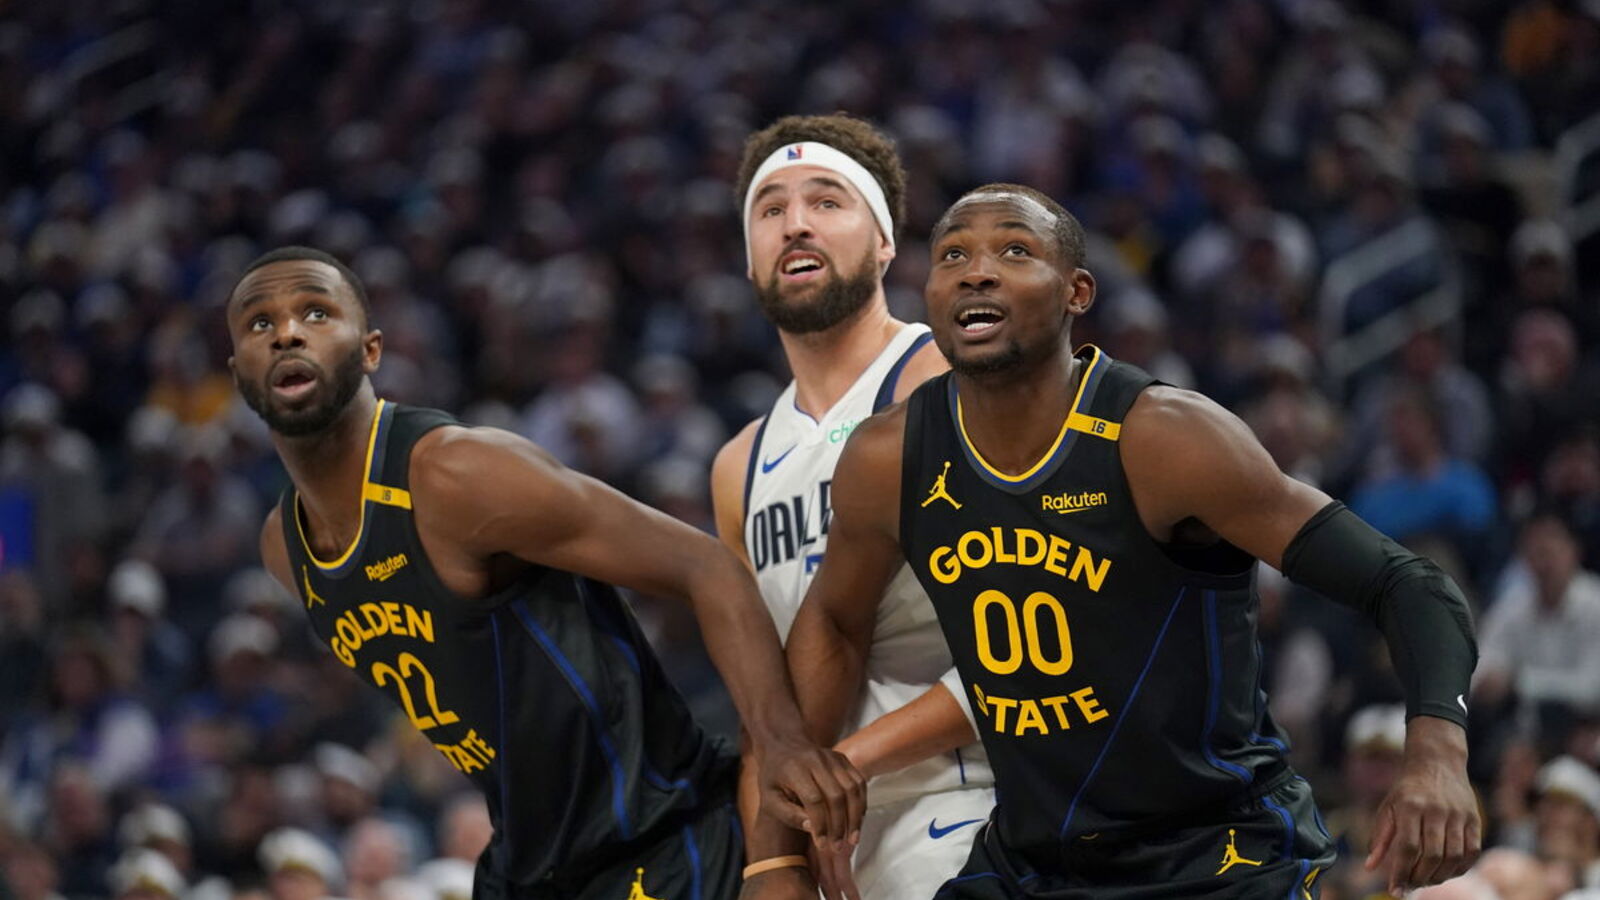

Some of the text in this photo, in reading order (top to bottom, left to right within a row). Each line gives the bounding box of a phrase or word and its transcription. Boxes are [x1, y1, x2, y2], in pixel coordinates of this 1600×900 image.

[1091, 420, 1106, 434] 16
[1042, 491, 1108, 512] Rakuten
[365, 553, 408, 581] Rakuten
[929, 527, 1112, 592] GOLDEN
[331, 602, 435, 668] GOLDEN
[973, 589, 1073, 676] 00
[371, 652, 460, 731] 22
[973, 683, 1110, 736] STATE
[433, 728, 496, 774] TATE
